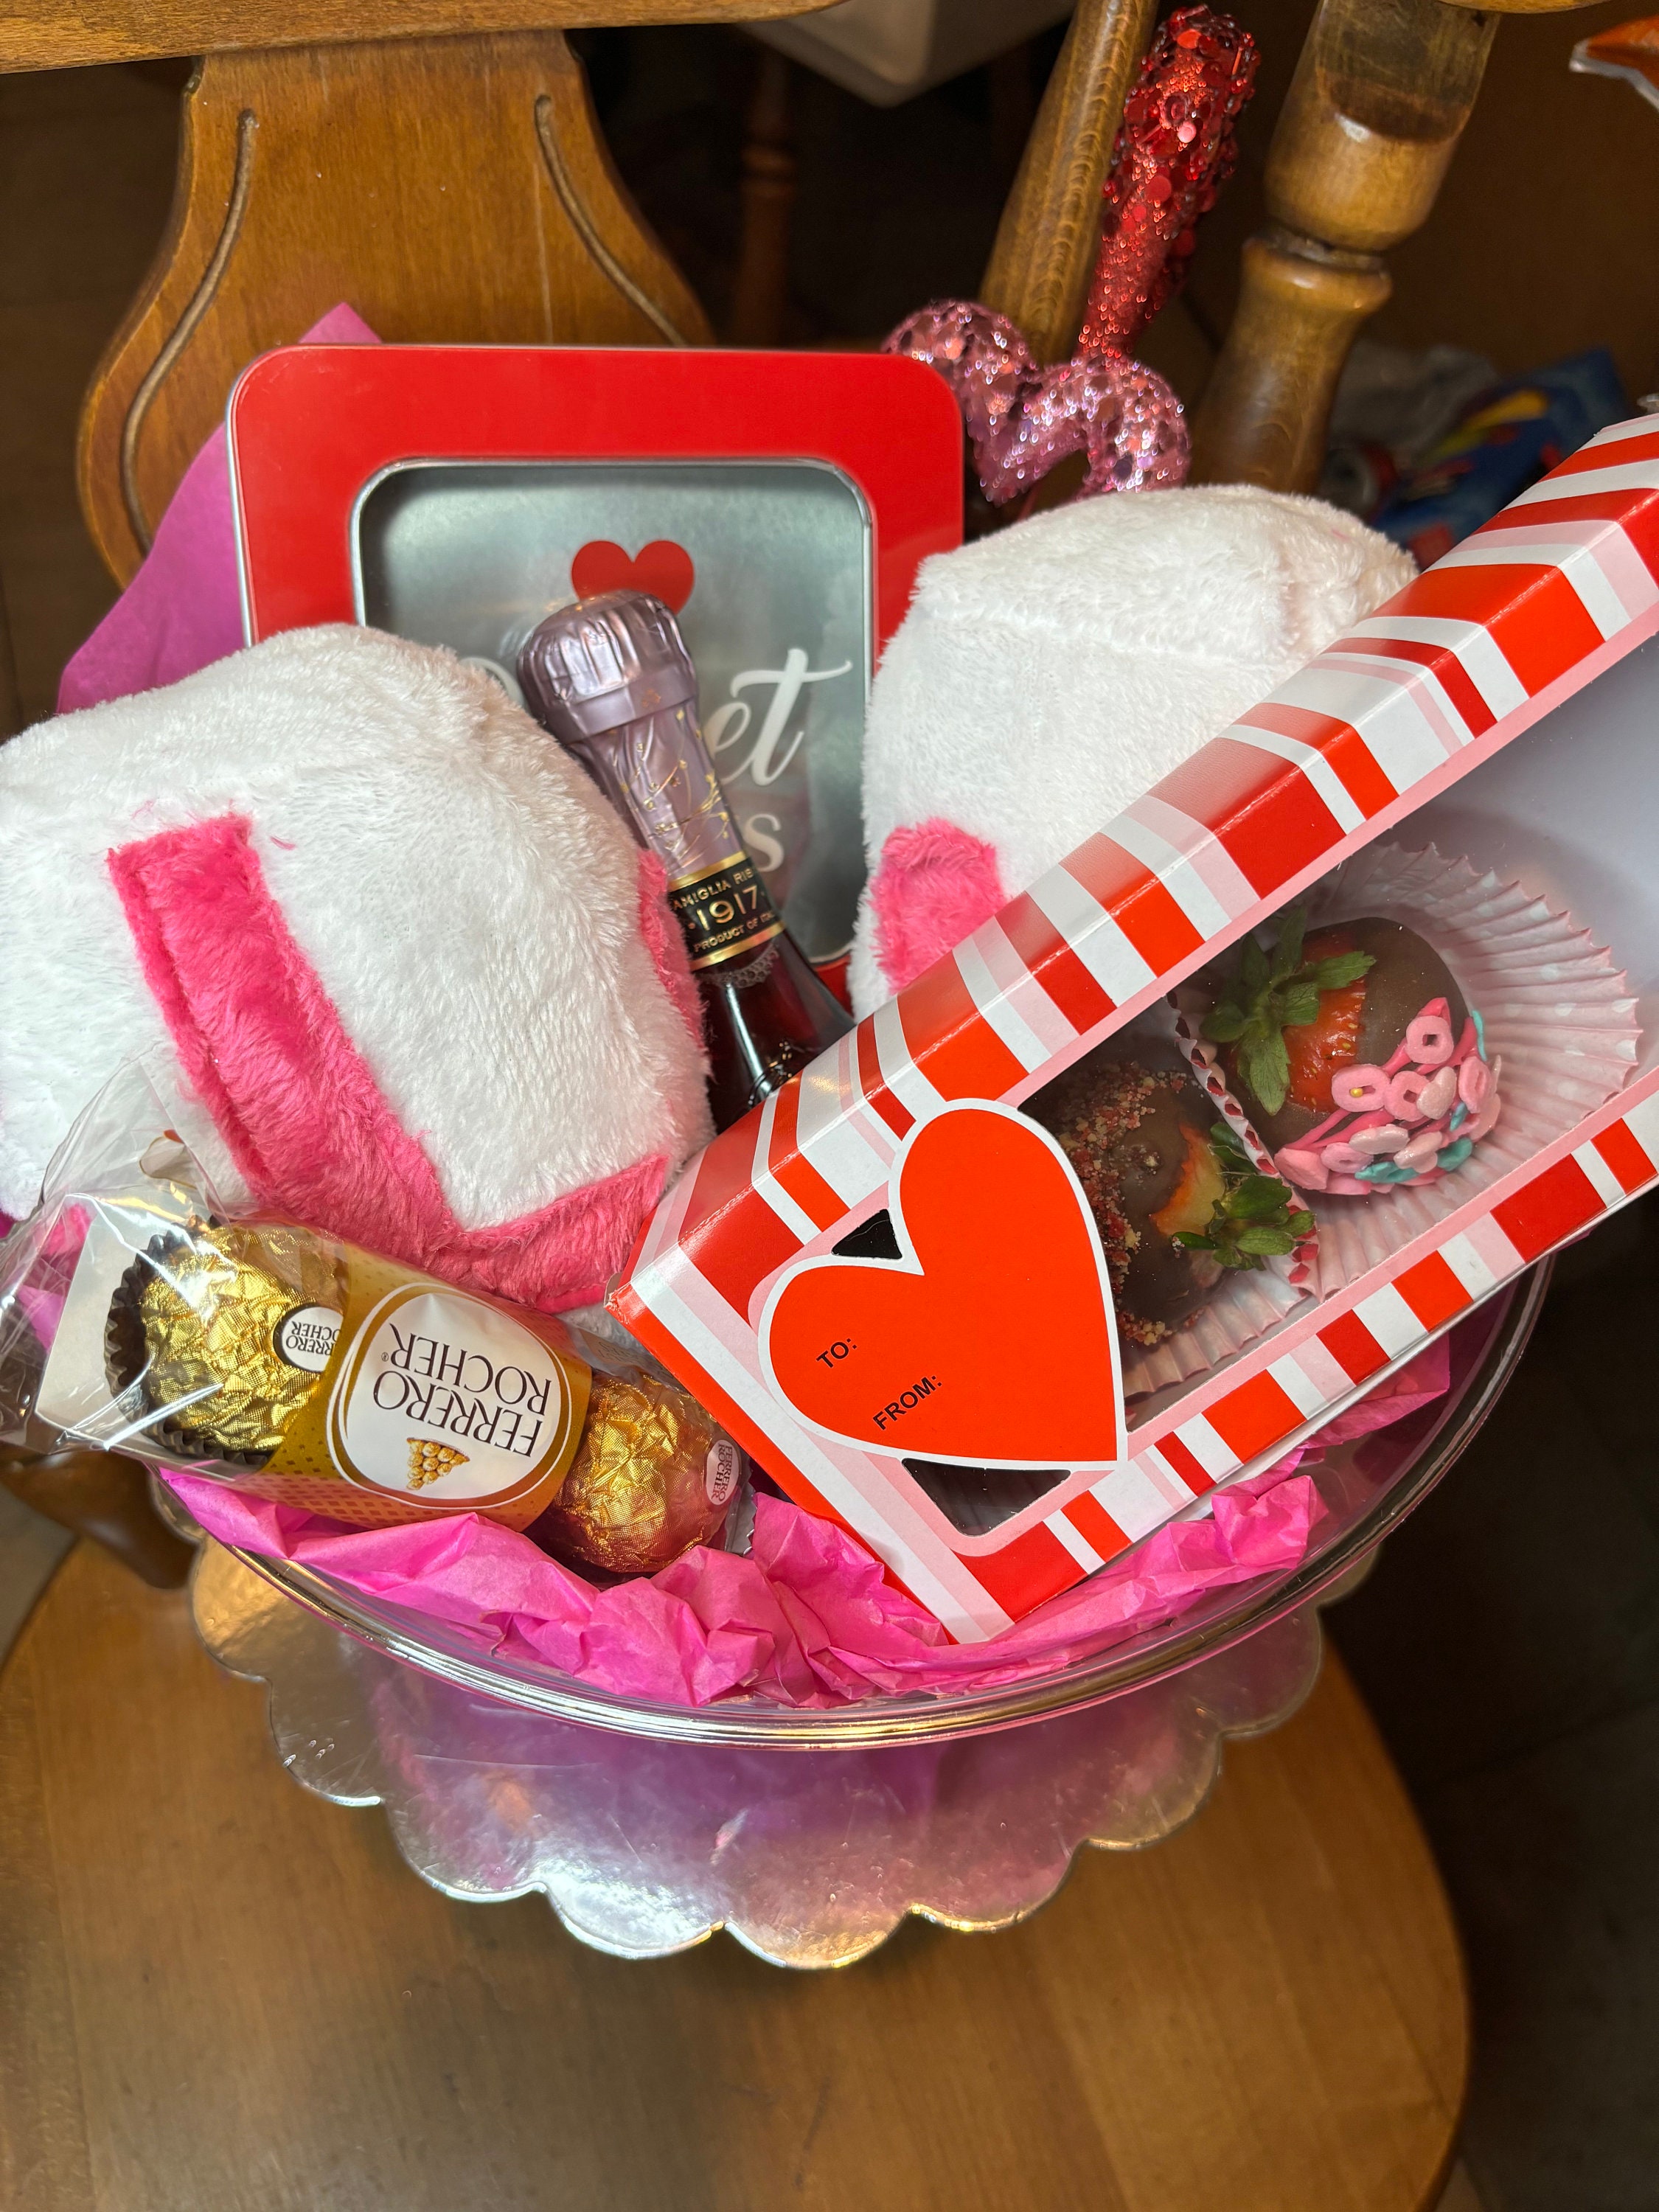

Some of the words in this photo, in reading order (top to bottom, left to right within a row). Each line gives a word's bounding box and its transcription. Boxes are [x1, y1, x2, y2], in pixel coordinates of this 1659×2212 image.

[672, 879, 731, 911] AMIGLIA
[696, 885, 758, 931] 1917
[693, 924, 745, 953] PRODUCT
[746, 917, 759, 929] OF
[285, 1335, 335, 1356] RRERO
[291, 1321, 341, 1342] OCHER
[815, 1338, 858, 1368] TO:
[372, 1370, 543, 1458] FERRERO
[872, 1375, 942, 1430] FROM:
[711, 1443, 726, 1500] ROCHER
[718, 1444, 733, 1502] FERRERO
